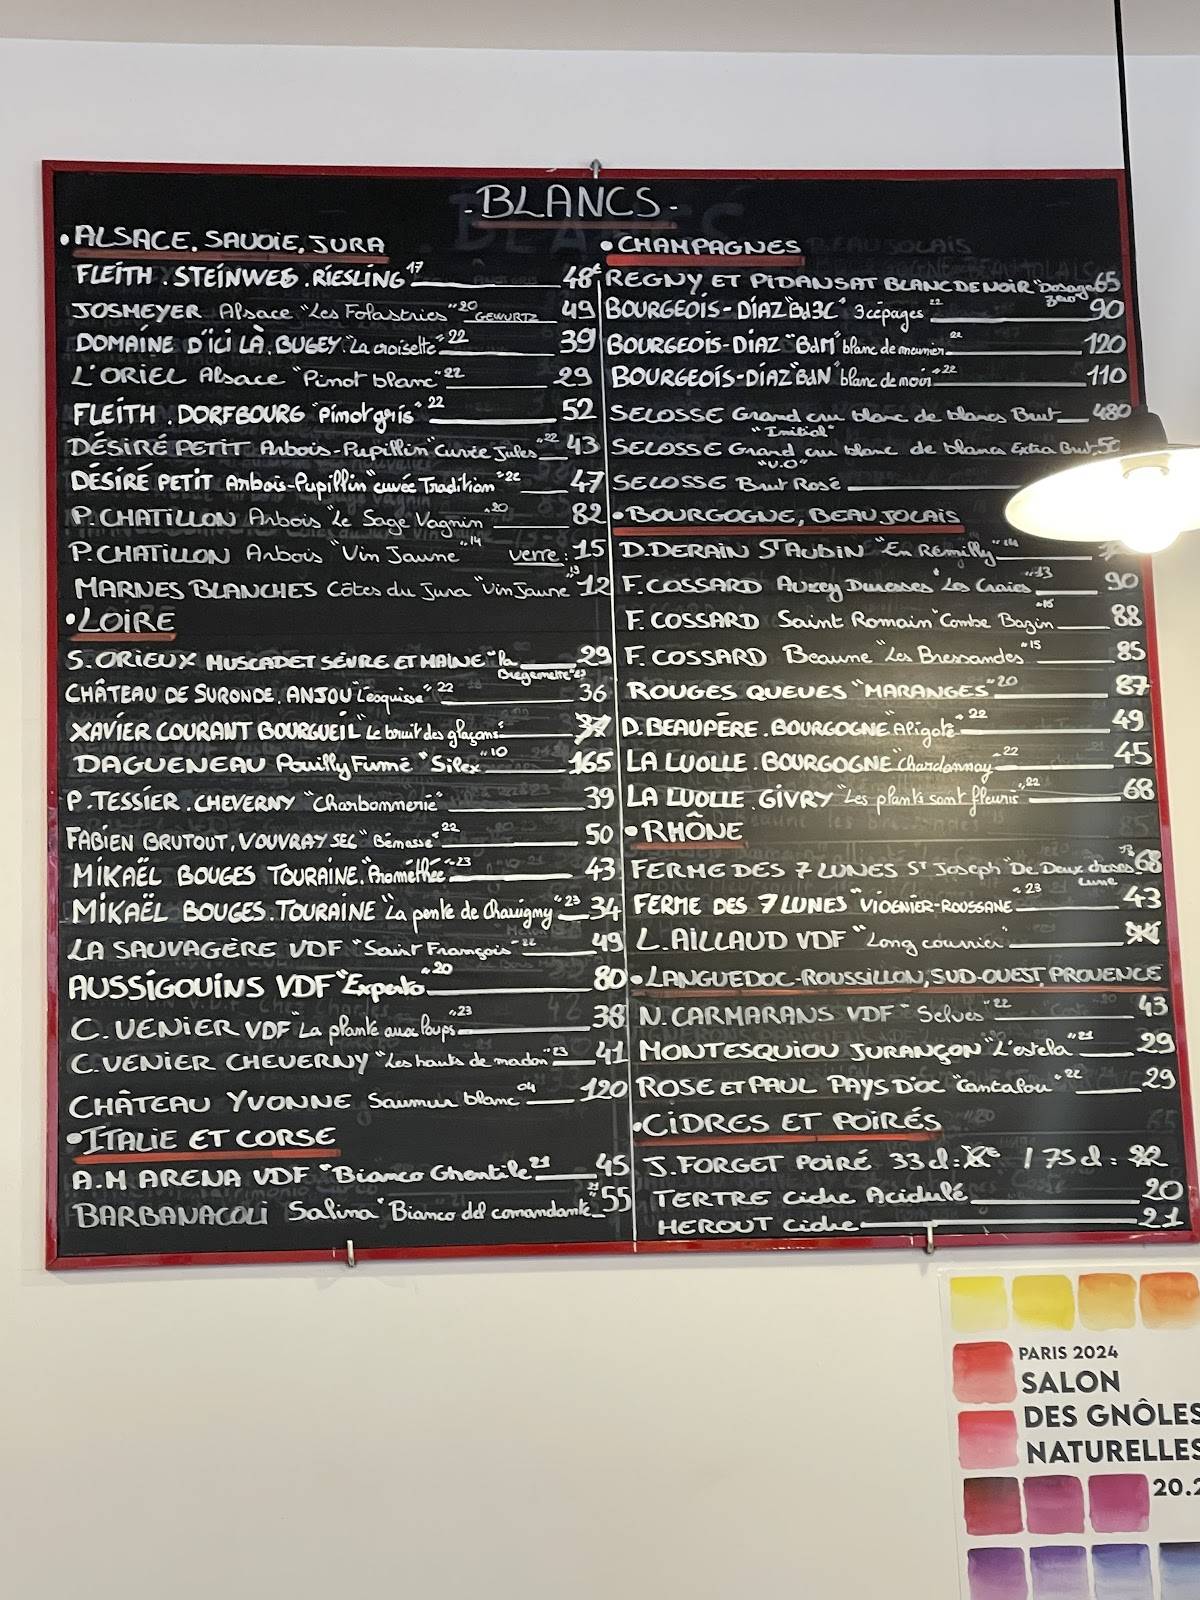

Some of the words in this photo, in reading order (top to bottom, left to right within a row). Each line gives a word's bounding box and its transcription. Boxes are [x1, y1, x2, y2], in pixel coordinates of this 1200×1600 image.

[308, 234, 385, 254] JURA
[618, 236, 801, 254] CHAMPAGNES
[605, 268, 702, 295] REGNY
[712, 274, 740, 288] ET
[1095, 271, 1121, 292] 65
[72, 302, 201, 322] JOSMEYER
[219, 302, 294, 320] Alsace
[562, 300, 595, 319] 49
[1090, 299, 1124, 320] 90
[560, 327, 596, 354] 39
[1084, 333, 1126, 354] 120
[200, 366, 286, 384] Alsace
[553, 366, 592, 386] 29
[1087, 366, 1127, 385] 110
[562, 398, 597, 419] 52
[610, 405, 724, 423] SELOSSE
[732, 406, 801, 423] Grand
[806, 412, 845, 423] cru
[852, 407, 908, 423] blanc
[914, 408, 942, 423] de
[947, 406, 1007, 424] blancs
[1011, 407, 1061, 422] Brut
[1093, 403, 1131, 420] 480
[567, 434, 600, 455] 43
[611, 439, 722, 456] SELOSSE
[728, 443, 795, 456] Grand
[845, 443, 898, 456] blanc
[910, 442, 936, 455] de
[1011, 443, 1057, 455] Extra
[570, 469, 605, 493] 47
[613, 475, 726, 490] SELOSSE
[735, 477, 788, 491] Brut
[793, 477, 841, 490] Rosé
[249, 507, 321, 528] Arbois
[364, 509, 412, 535] Sage
[571, 503, 607, 524] 82
[246, 544, 323, 564] Arbois
[572, 539, 606, 560] 15
[75, 577, 185, 599] MARNES
[188, 579, 317, 600] BLANCHES
[387, 583, 416, 597] du
[420, 584, 472, 600] Jura
[577, 577, 611, 596] 12
[646, 579, 762, 594] COSSARD
[1104, 572, 1138, 589] 90
[651, 612, 759, 629] COSSARD
[778, 610, 844, 629] Saint
[1111, 604, 1142, 626] 88
[206, 654, 316, 671] MUSCADET
[394, 656, 418, 669] ET
[576, 646, 612, 666] 29
[652, 648, 767, 666] COSSARD
[782, 644, 873, 663] Beaune
[1116, 641, 1145, 661] 85
[65, 678, 157, 703] CHÂTEAU
[165, 686, 189, 703] DE
[579, 684, 607, 702] 36
[627, 681, 737, 701] ROUGES
[746, 685, 847, 701] QUEUES
[1116, 674, 1149, 695] 87
[157, 722, 253, 741] COURANT
[424, 725, 444, 741] des
[1112, 709, 1144, 732] 49
[73, 755, 265, 774] DAGUENEAU
[568, 751, 614, 775] 165
[626, 749, 657, 772] LA
[1114, 742, 1152, 765] 45
[584, 787, 614, 809] 39
[626, 784, 657, 807] LA
[929, 786, 963, 804] sont
[1123, 778, 1154, 800] 68
[585, 823, 613, 845] 50
[640, 811, 744, 843] RHÔNE
[178, 864, 256, 886] BOUGES
[585, 857, 615, 881] 43
[631, 859, 725, 879] FERME
[734, 862, 785, 877] DES
[796, 862, 812, 879] 7
[817, 863, 898, 878] LUNES
[933, 862, 1000, 880] Joseph
[1040, 863, 1083, 875] Deux
[1135, 849, 1161, 873] 68
[633, 893, 701, 915] FERME
[713, 897, 747, 915] DES
[780, 895, 847, 914] LUNES
[1123, 886, 1161, 909] 43
[413, 898, 455, 934] pente
[461, 901, 479, 919] de
[590, 897, 621, 921] 34
[68, 938, 104, 960] LA
[113, 938, 277, 959] SAUVAGÈRE
[290, 940, 343, 957] VDF
[591, 932, 623, 951] 49
[797, 931, 846, 949] VDF
[594, 966, 627, 990] 80
[385, 1027, 419, 1038] aux
[593, 1004, 625, 1028] 38
[672, 1006, 833, 1027] CARMARANS
[847, 1006, 894, 1022] VDF
[1138, 995, 1168, 1016] 43
[416, 1054, 464, 1068] hauts
[469, 1053, 492, 1067] de
[595, 1041, 628, 1065] 41
[1137, 1032, 1175, 1054] 29
[636, 1076, 714, 1097] ROSE
[749, 1076, 818, 1094] PAUL
[827, 1075, 889, 1100] PAYS
[1143, 1068, 1175, 1089] 29
[69, 1090, 211, 1119] CHÂTEAU
[226, 1089, 351, 1112] YVONNE
[368, 1093, 458, 1109] Saumur
[464, 1091, 520, 1106] blanc
[580, 1078, 627, 1101] 120
[782, 1112, 822, 1131] ET
[189, 1129, 230, 1150] ET
[236, 1127, 336, 1148] CORSE
[139, 1169, 241, 1188] ARENA
[253, 1167, 309, 1185] VDF
[595, 1153, 630, 1176] 45
[602, 1186, 631, 1212] 55
[653, 1190, 772, 1208] TERTRE
[1143, 1178, 1184, 1200] 20
[658, 1217, 773, 1235] HEROUT
[1139, 1207, 1183, 1228] 21
[1019, 1346, 1067, 1360] PARIS
[1073, 1345, 1118, 1359] 2024
[1022, 1370, 1120, 1394] SALON
[1024, 1405, 1078, 1428] DES
